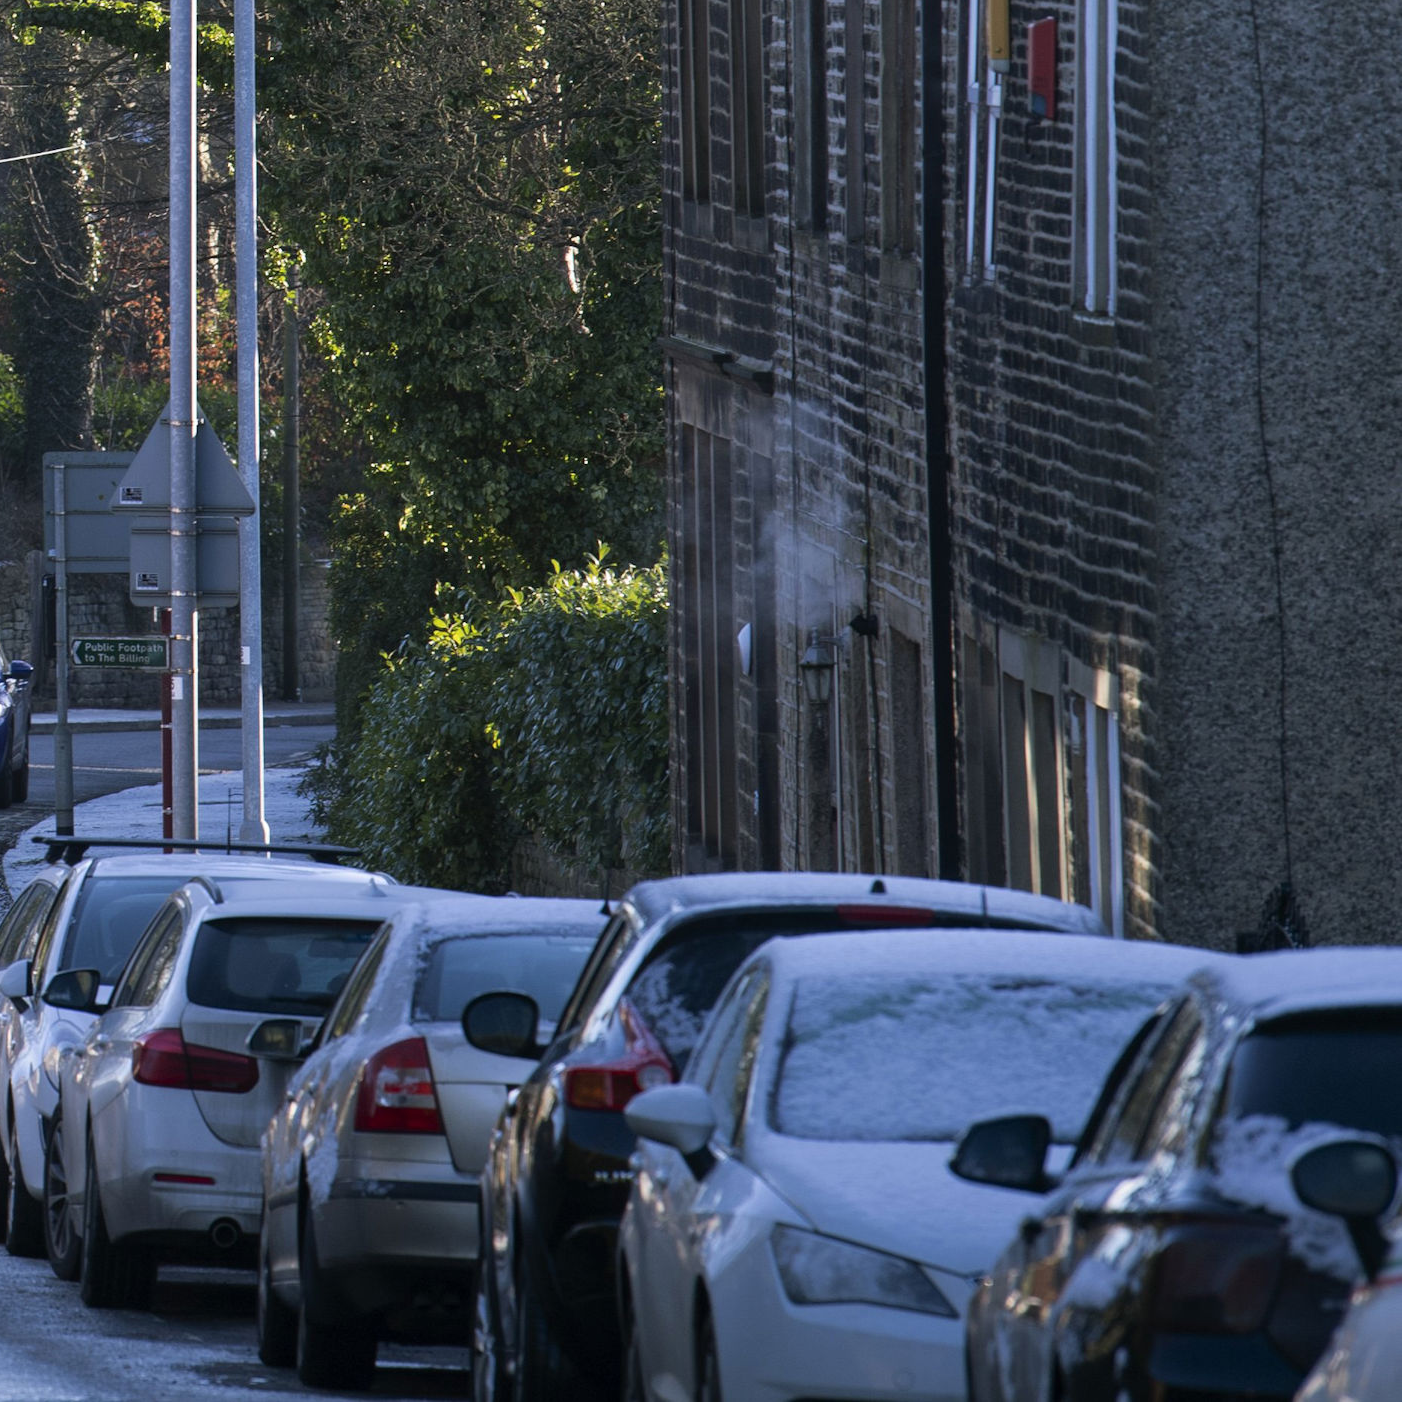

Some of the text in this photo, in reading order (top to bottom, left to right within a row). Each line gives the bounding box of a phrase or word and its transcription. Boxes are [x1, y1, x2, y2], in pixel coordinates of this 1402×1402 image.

[85, 642, 163, 653] Public Footpath
[85, 653, 150, 664] to The Billing
